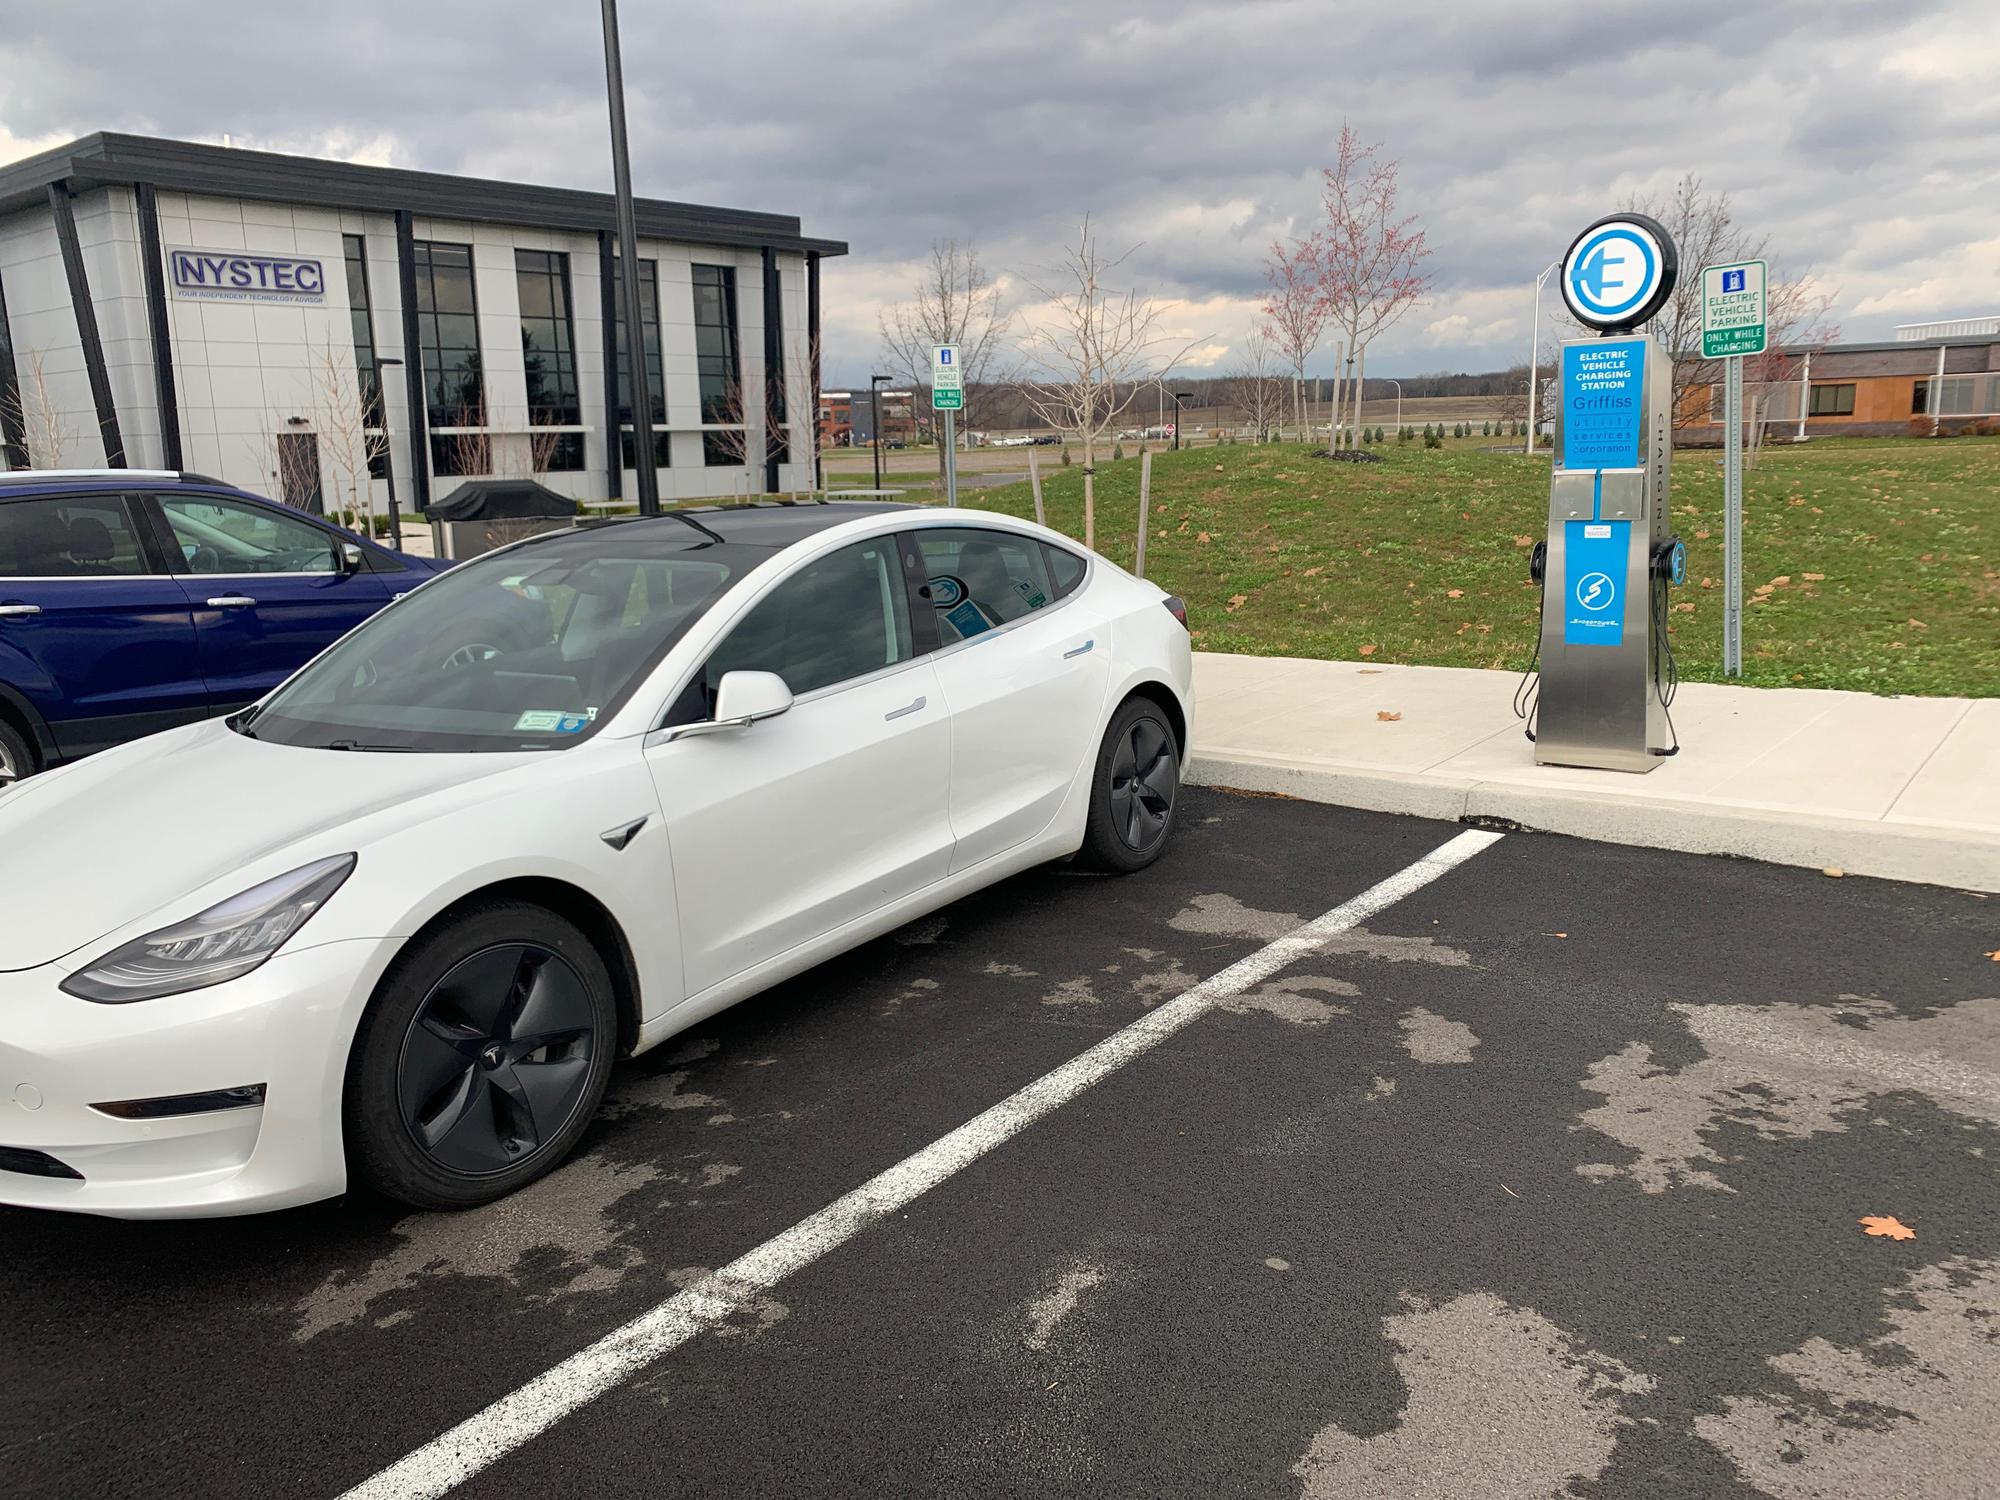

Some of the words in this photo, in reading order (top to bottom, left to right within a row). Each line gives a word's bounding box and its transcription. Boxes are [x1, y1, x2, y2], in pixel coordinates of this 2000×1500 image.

[179, 256, 319, 290] NYSTEC
[199, 291, 247, 300] INDEPENDENT
[249, 294, 293, 302] TECHNOLOGY
[295, 296, 323, 304] ADVISOR
[1709, 291, 1759, 306] ELECTRIC
[1711, 303, 1757, 316] VEHICLE
[1711, 314, 1758, 327] PARKING
[1706, 331, 1730, 343] ONLY
[1734, 327, 1762, 339] WHILE
[1711, 340, 1757, 353] CHARGING
[1579, 350, 1629, 361] ELECTRIC
[1582, 360, 1626, 370] VEHICLE
[1575, 370, 1631, 381] CHARGING
[1581, 380, 1625, 390] STATION
[1573, 395, 1632, 410] Griffiss
[1574, 417, 1632, 427] utility
[1573, 432, 1631, 441] services
[1573, 445, 1631, 454] corporation
[1656, 413, 1664, 537] CHARGING
